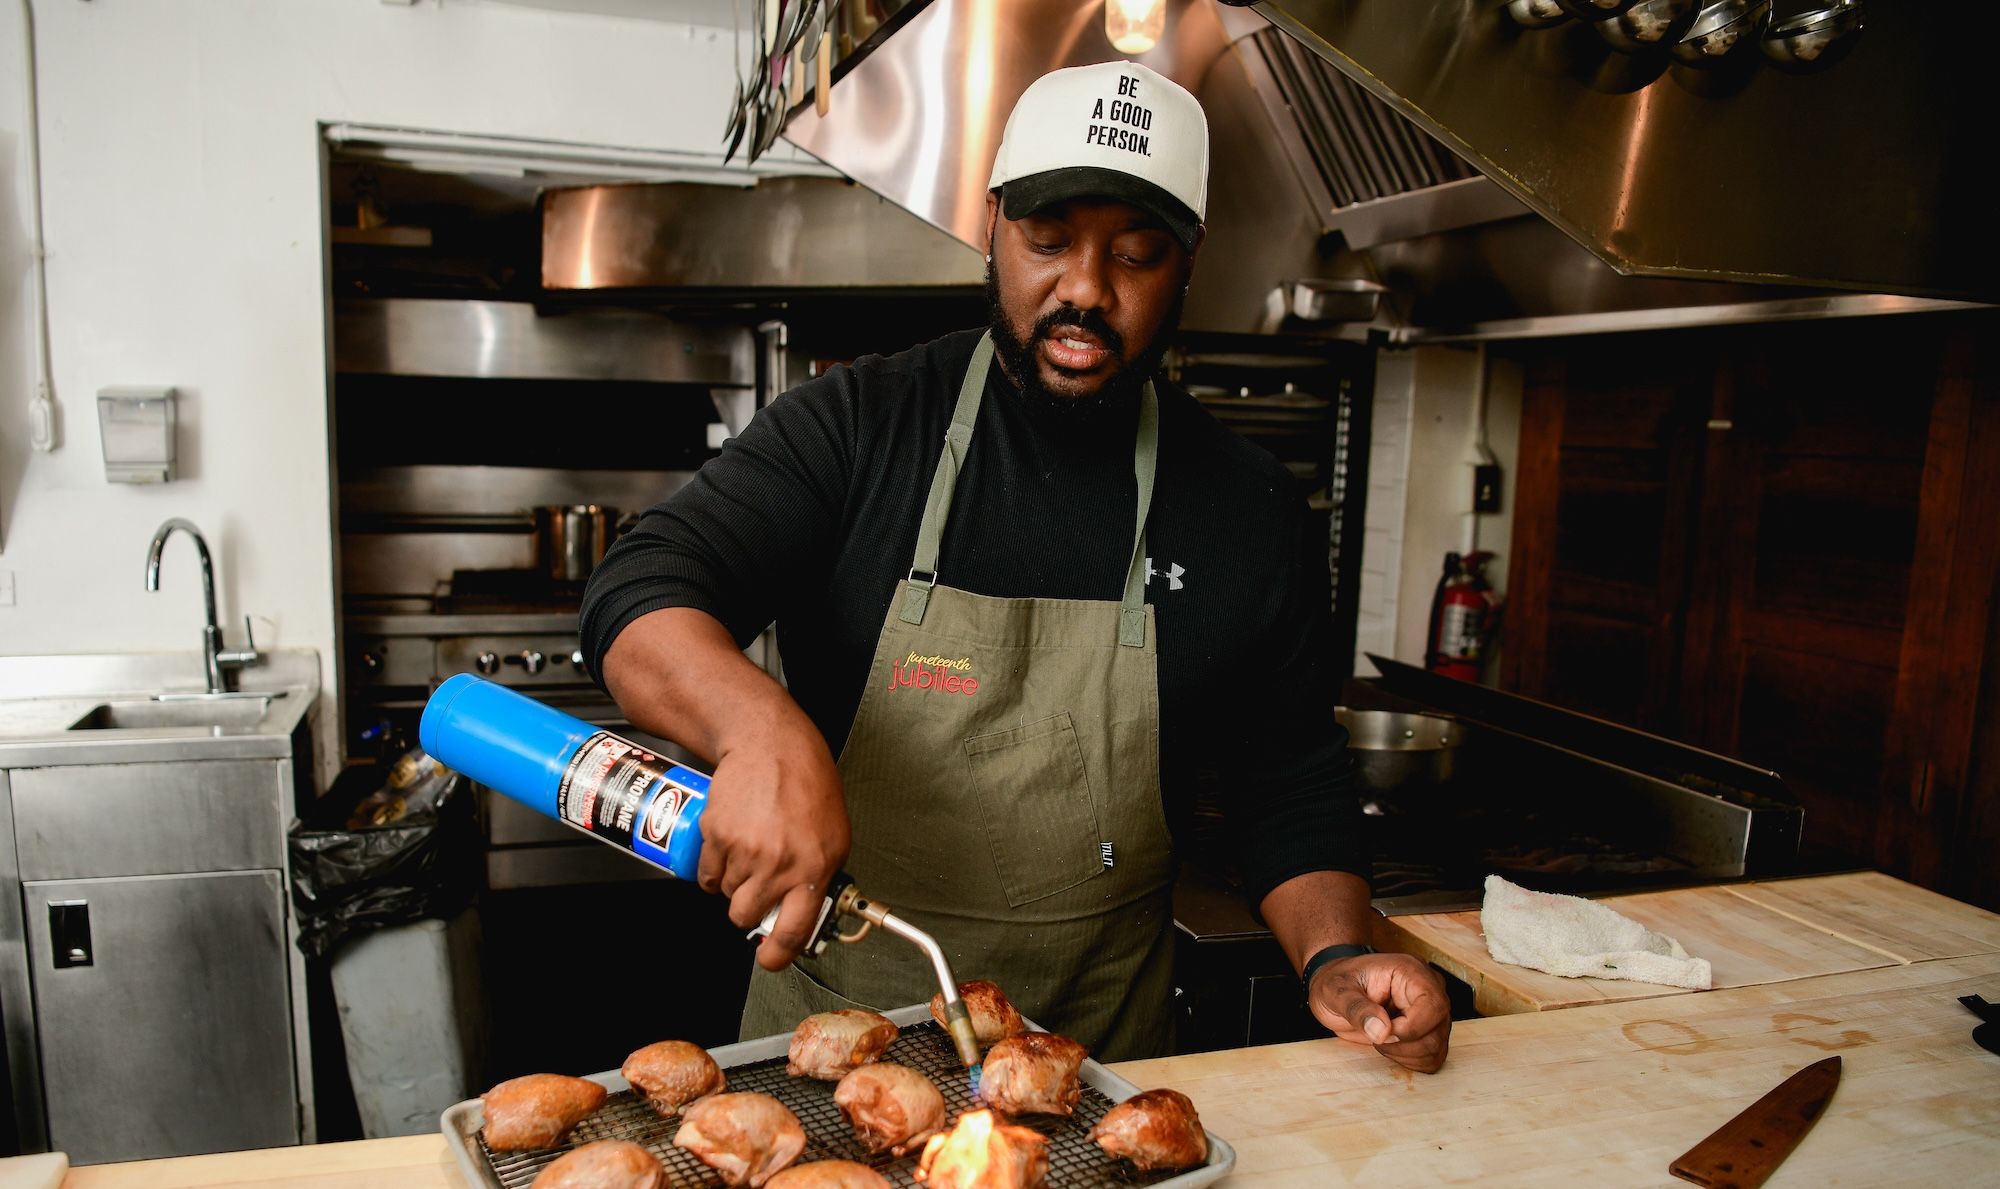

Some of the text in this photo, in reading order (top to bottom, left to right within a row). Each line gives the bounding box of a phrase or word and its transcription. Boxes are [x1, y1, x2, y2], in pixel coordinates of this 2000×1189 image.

[1118, 75, 1140, 99] BE
[1092, 98, 1152, 131] A GOOD
[1087, 125, 1152, 157] PERSON.
[887, 659, 979, 696] jubilee
[616, 770, 653, 832] PROPANE
